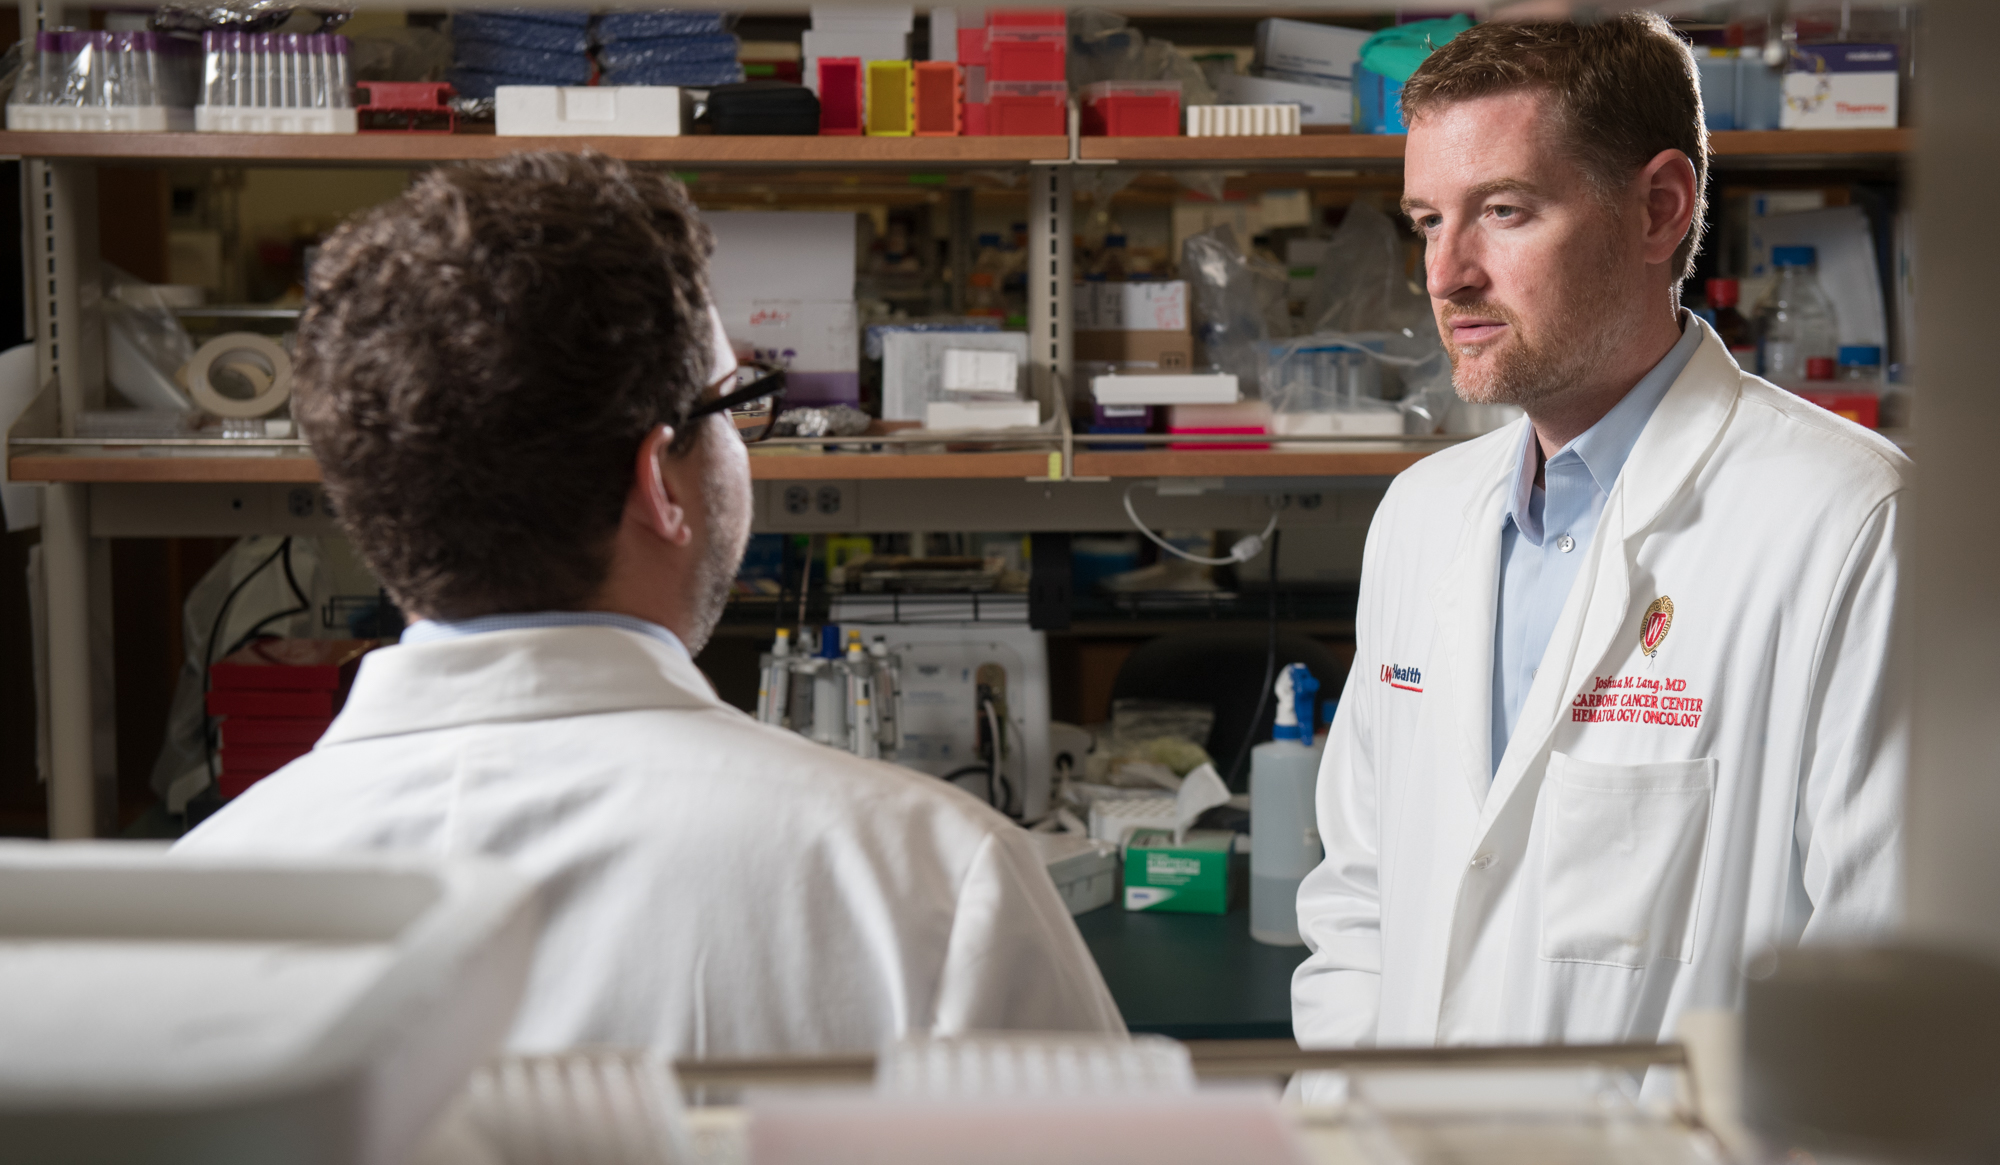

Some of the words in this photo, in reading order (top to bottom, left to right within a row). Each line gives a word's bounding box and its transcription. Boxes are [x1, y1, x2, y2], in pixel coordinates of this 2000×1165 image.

[1592, 675, 1623, 693] Joshua
[1623, 676, 1634, 689] M.
[1635, 676, 1663, 694] Lang,
[1664, 677, 1687, 692] MD
[1572, 693, 1619, 708] CARBONE
[1620, 693, 1659, 709] CANCER
[1660, 696, 1703, 712] CENTER
[1643, 709, 1702, 728] ONCOLOGY
